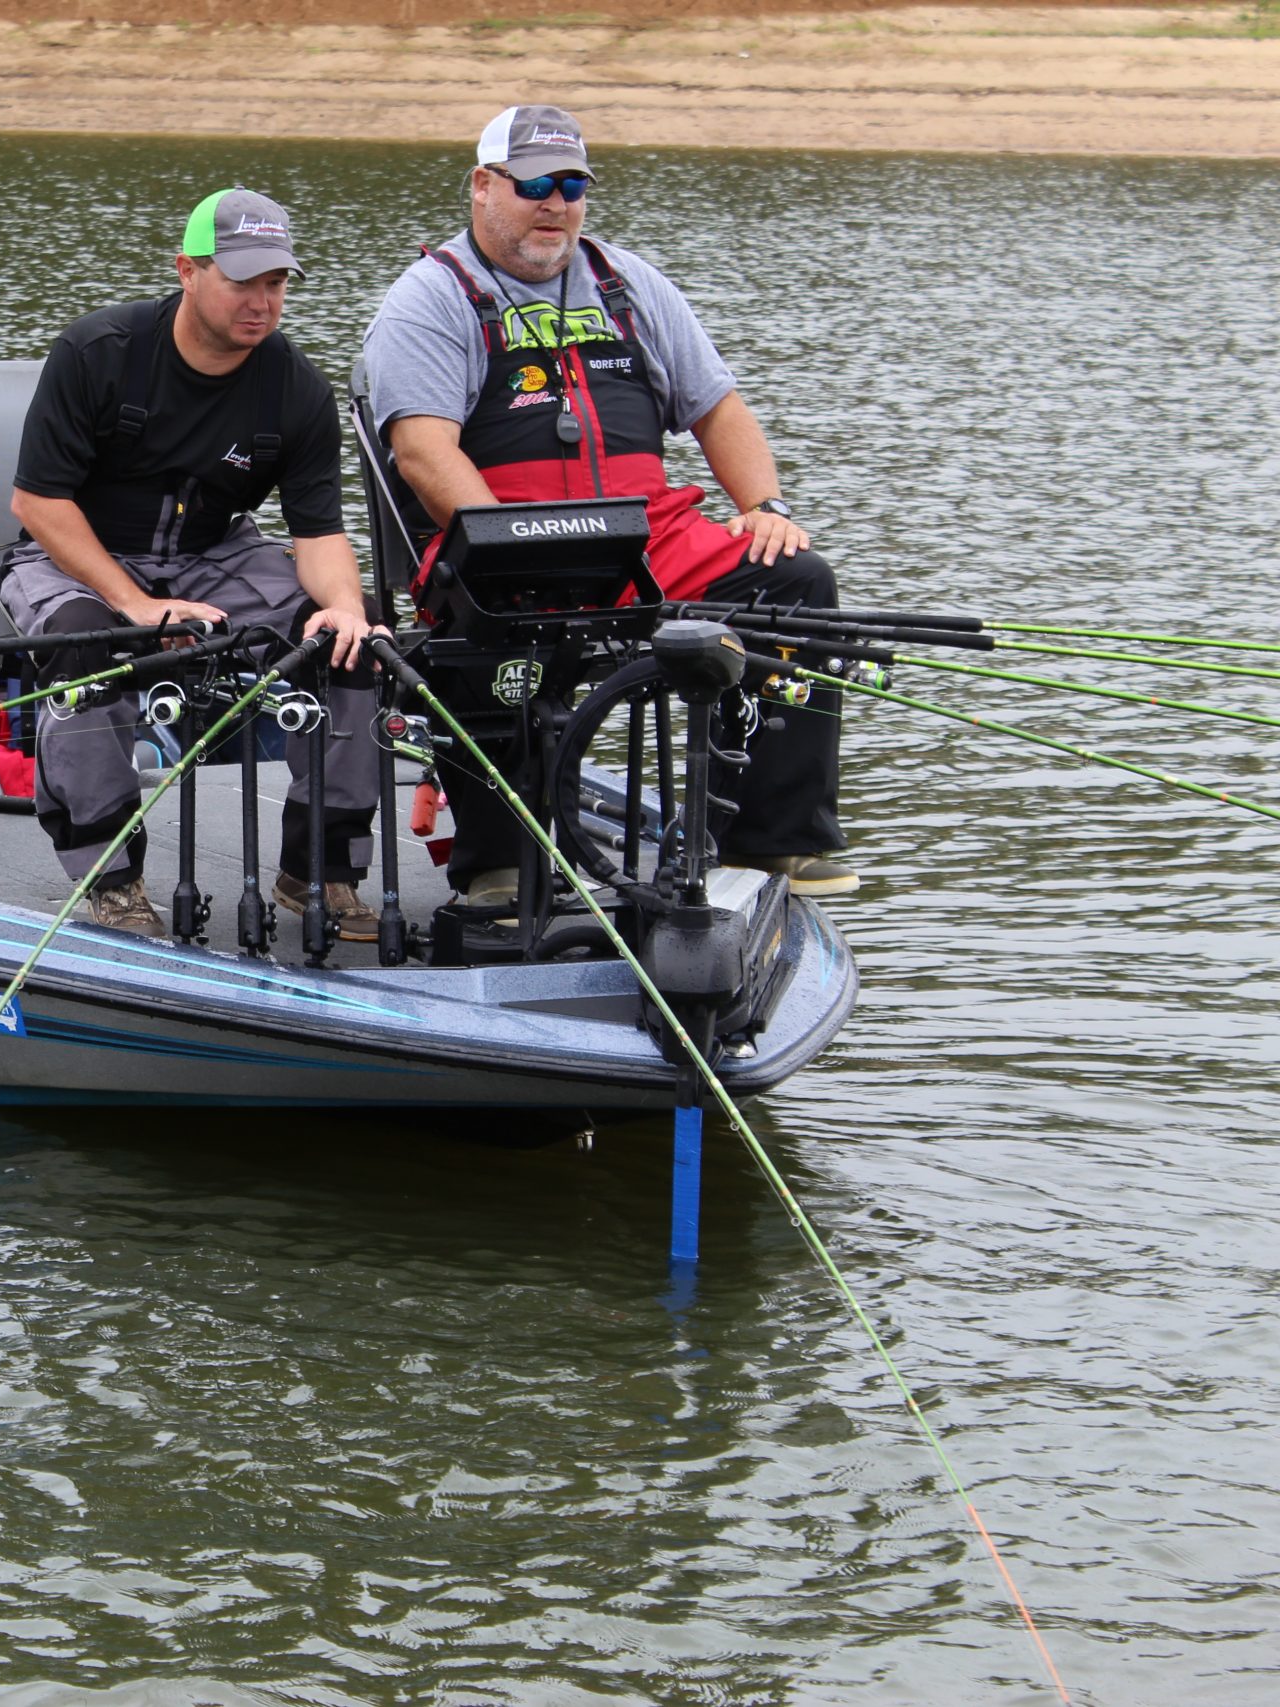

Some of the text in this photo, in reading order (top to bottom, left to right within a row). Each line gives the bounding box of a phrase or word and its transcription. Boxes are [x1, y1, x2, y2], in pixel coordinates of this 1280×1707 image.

[589, 358, 632, 370] GORE-TEX
[511, 517, 608, 537] GARMIN
[496, 681, 540, 692] CRAPIE
